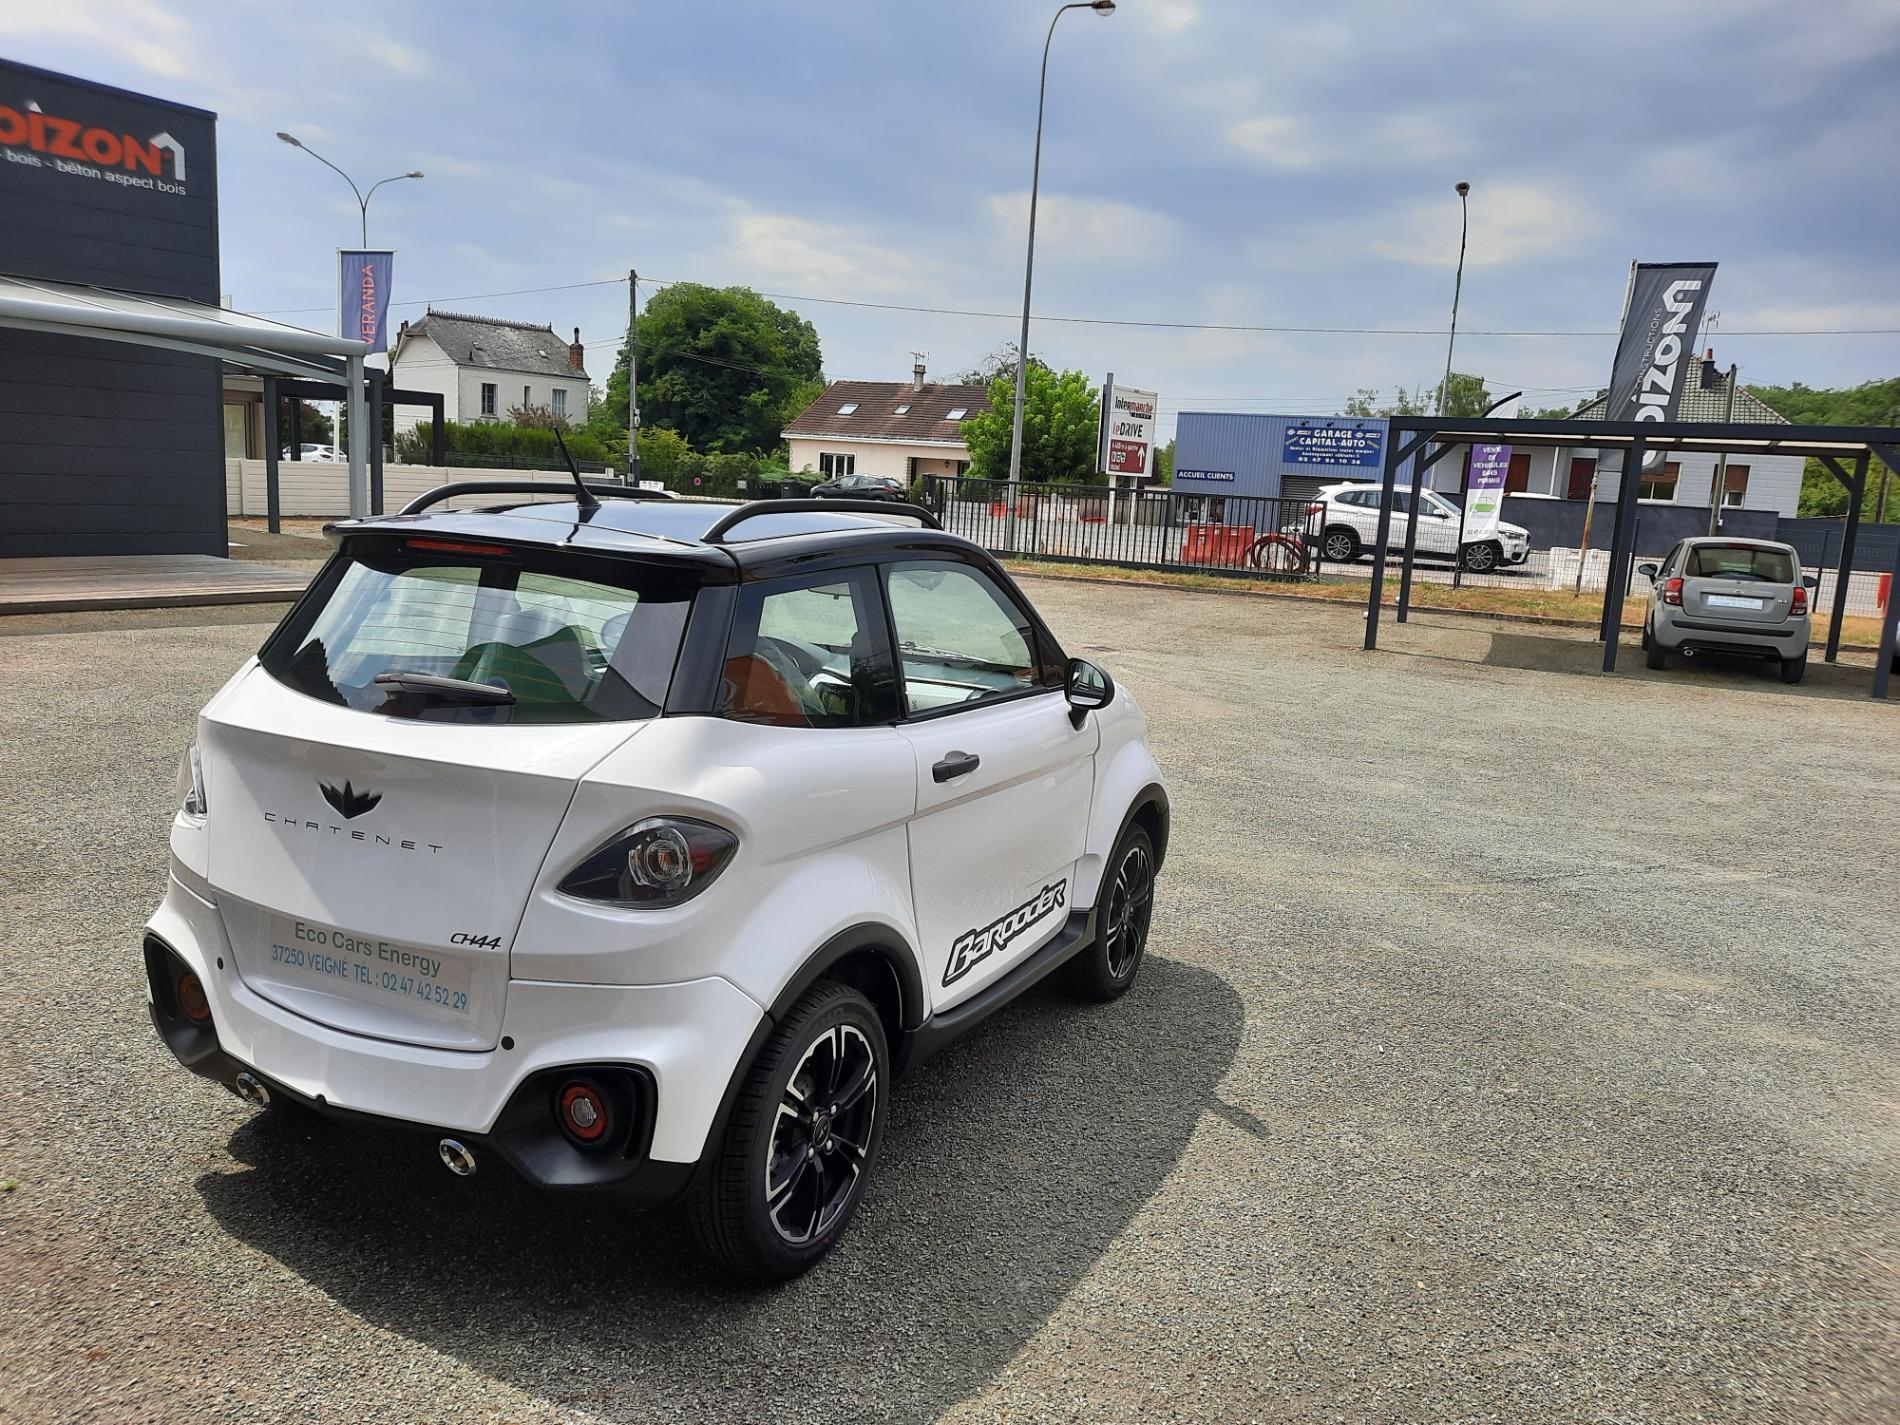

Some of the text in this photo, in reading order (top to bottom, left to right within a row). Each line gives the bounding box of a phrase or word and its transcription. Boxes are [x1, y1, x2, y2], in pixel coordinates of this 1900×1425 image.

[7, 149, 41, 167] bois
[57, 159, 101, 178] béton
[104, 172, 154, 189] aspect
[157, 179, 187, 195] bois
[361, 264, 376, 345] VERANDA
[1314, 429, 1352, 438] GARAGE
[1178, 471, 1234, 480] ACCUEIL CLIENTS
[264, 812, 443, 854] CHATENET
[295, 921, 441, 978] Eco Cars Energy
[450, 932, 502, 950] CH44
[272, 944, 305, 967] 37250
[307, 952, 348, 978] VEIGNÉ
[382, 971, 397, 992] 02
[400, 976, 414, 995] 47
[417, 981, 431, 1001] 42
[435, 985, 449, 1006] 52
[452, 990, 467, 1010] 29
